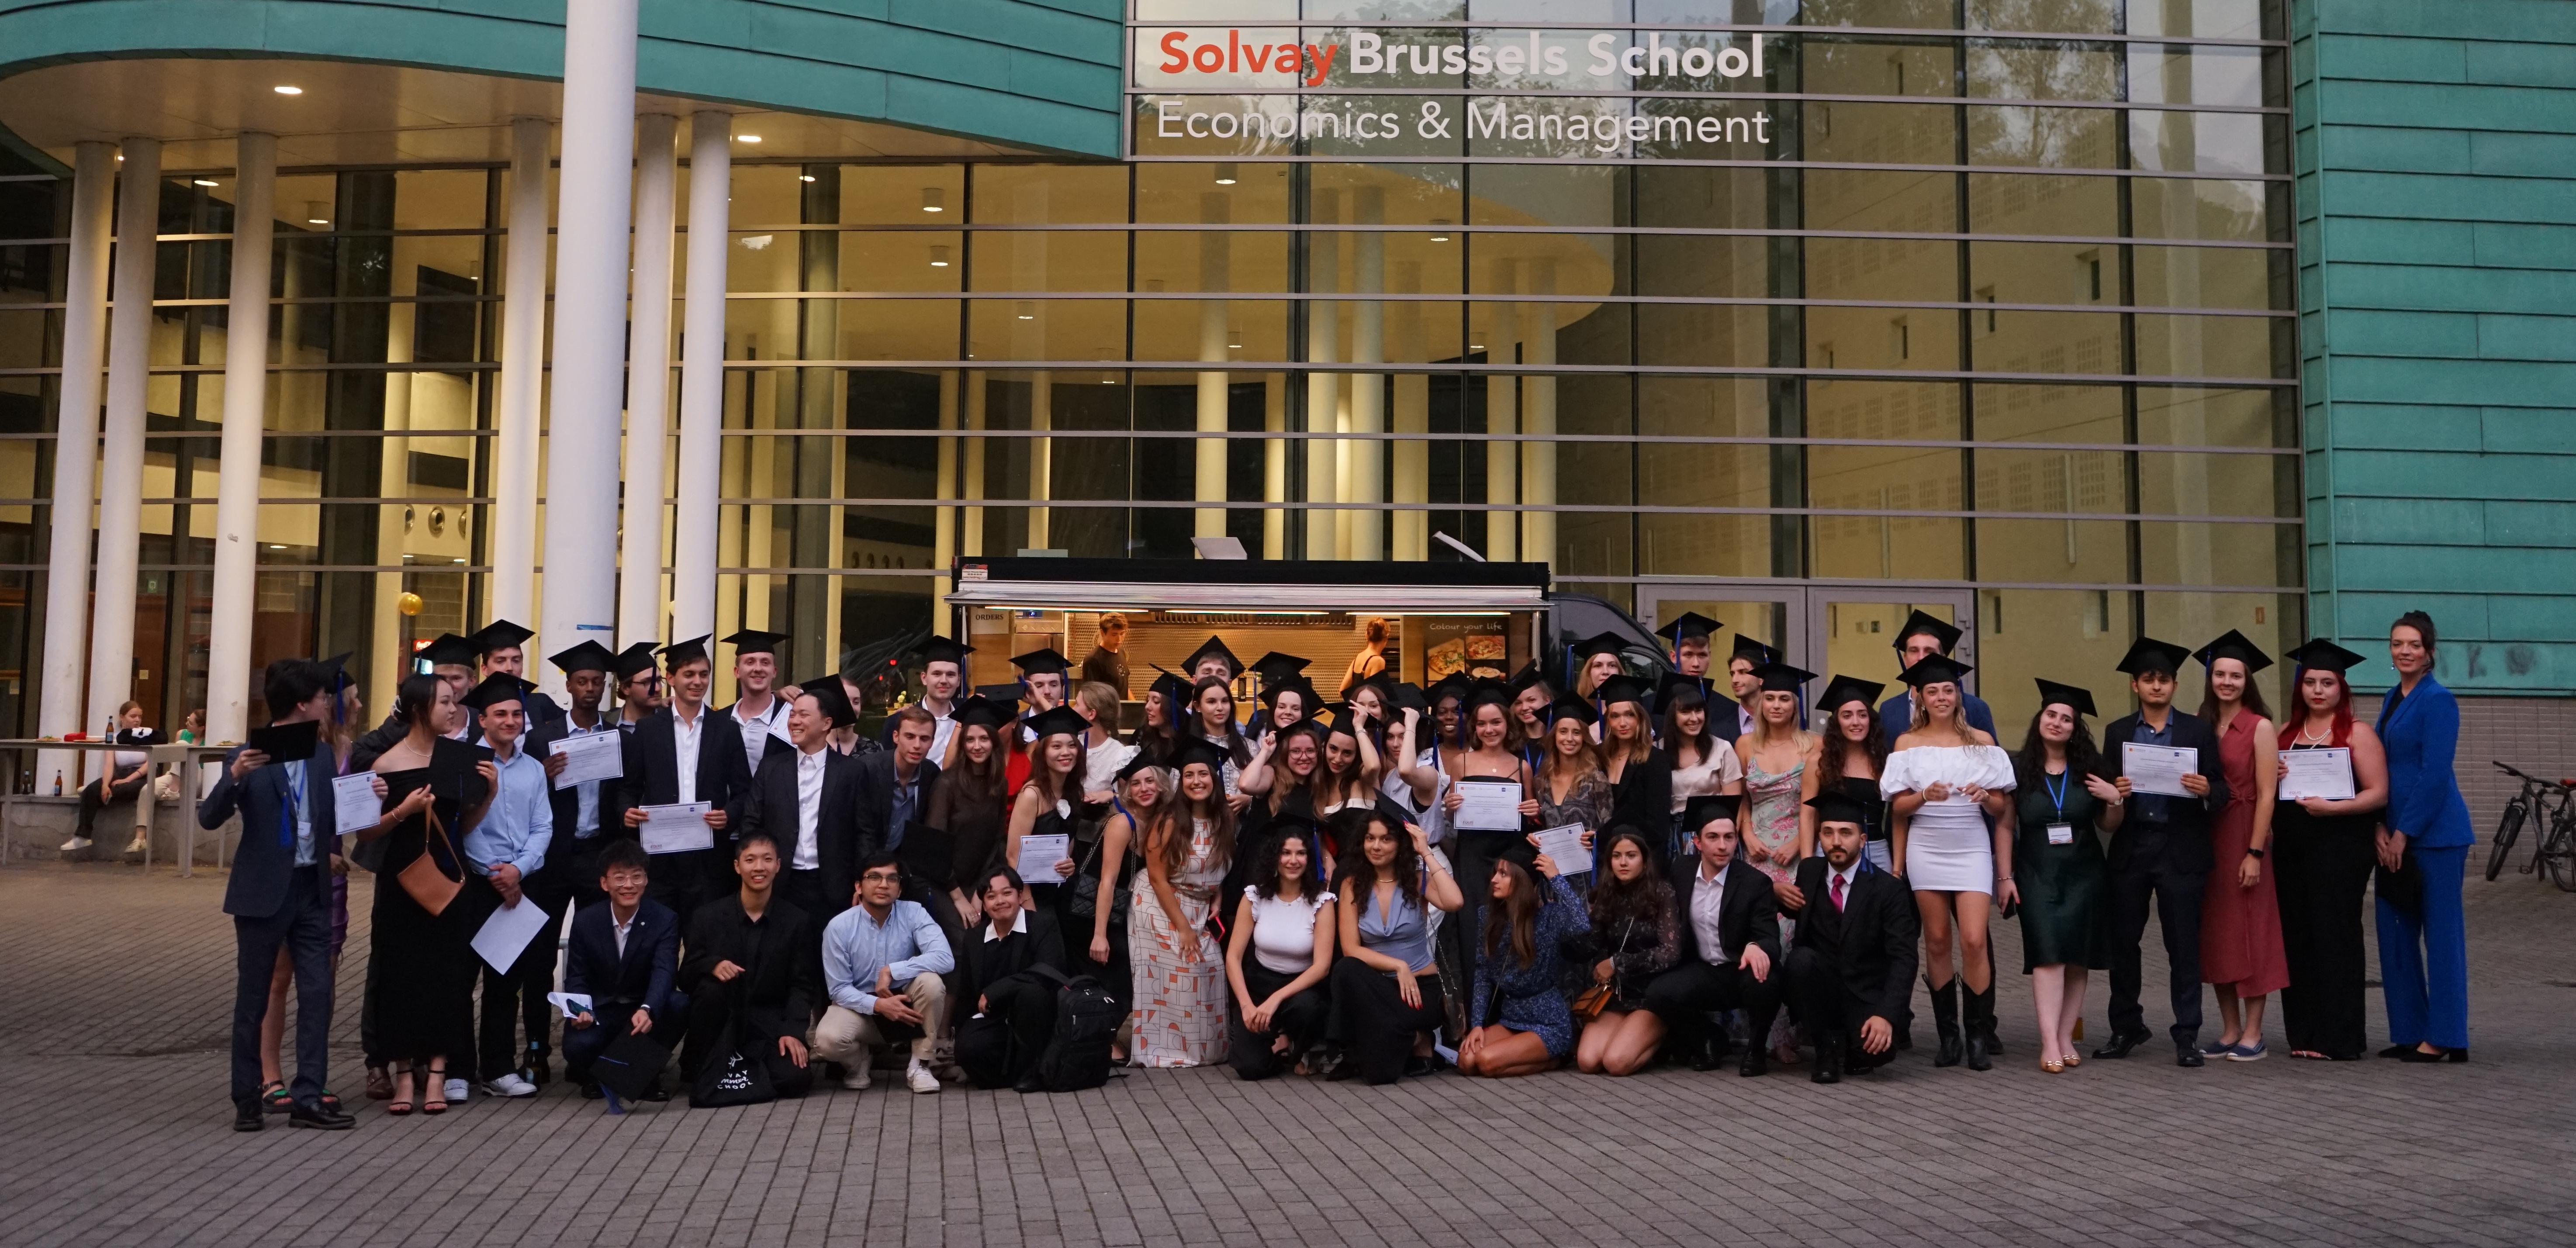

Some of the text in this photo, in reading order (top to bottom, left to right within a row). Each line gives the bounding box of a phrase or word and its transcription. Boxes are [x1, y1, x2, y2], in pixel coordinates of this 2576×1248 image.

[1158, 30, 1763, 86] Solvay Brussels School
[1158, 101, 1769, 152] Economics & Management
[1487, 622, 1502, 631] life
